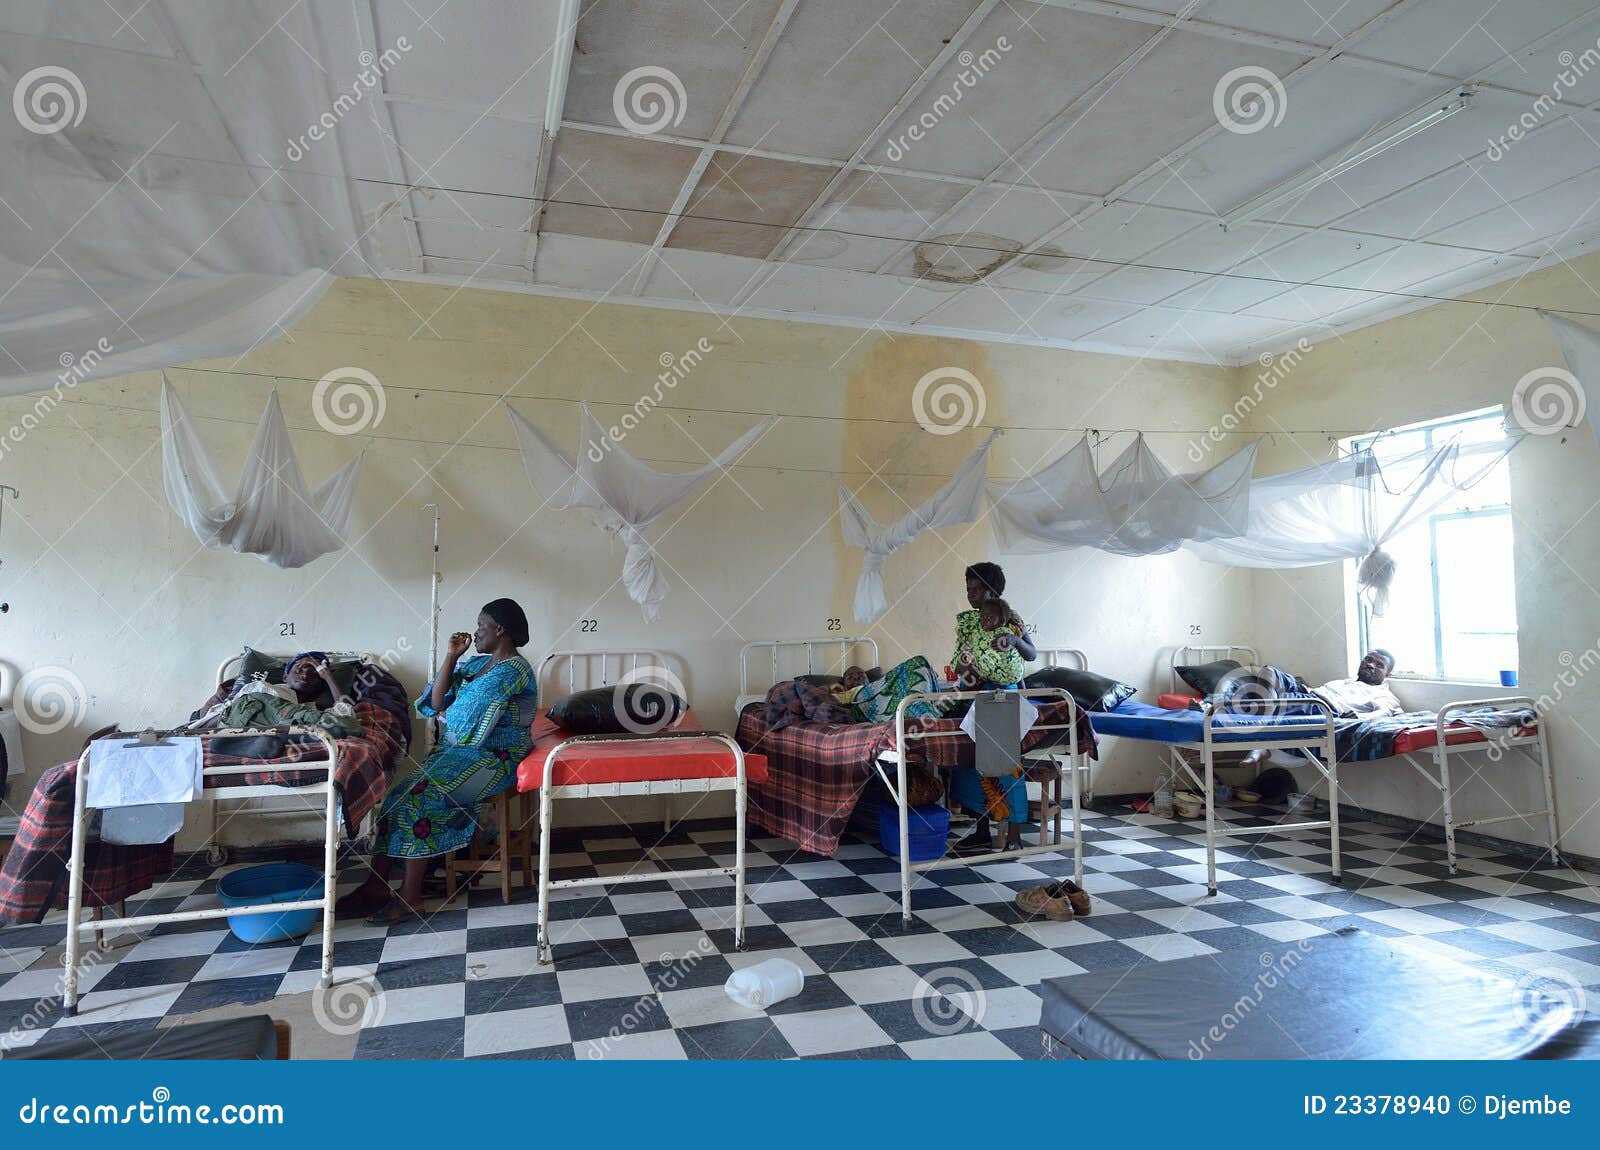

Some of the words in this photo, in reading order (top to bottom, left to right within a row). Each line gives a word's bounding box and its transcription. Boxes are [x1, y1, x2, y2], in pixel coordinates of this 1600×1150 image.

[279, 622, 297, 636] 21
[581, 619, 598, 632] 22
[827, 618, 842, 631] 23
[1190, 624, 1202, 635] 25
